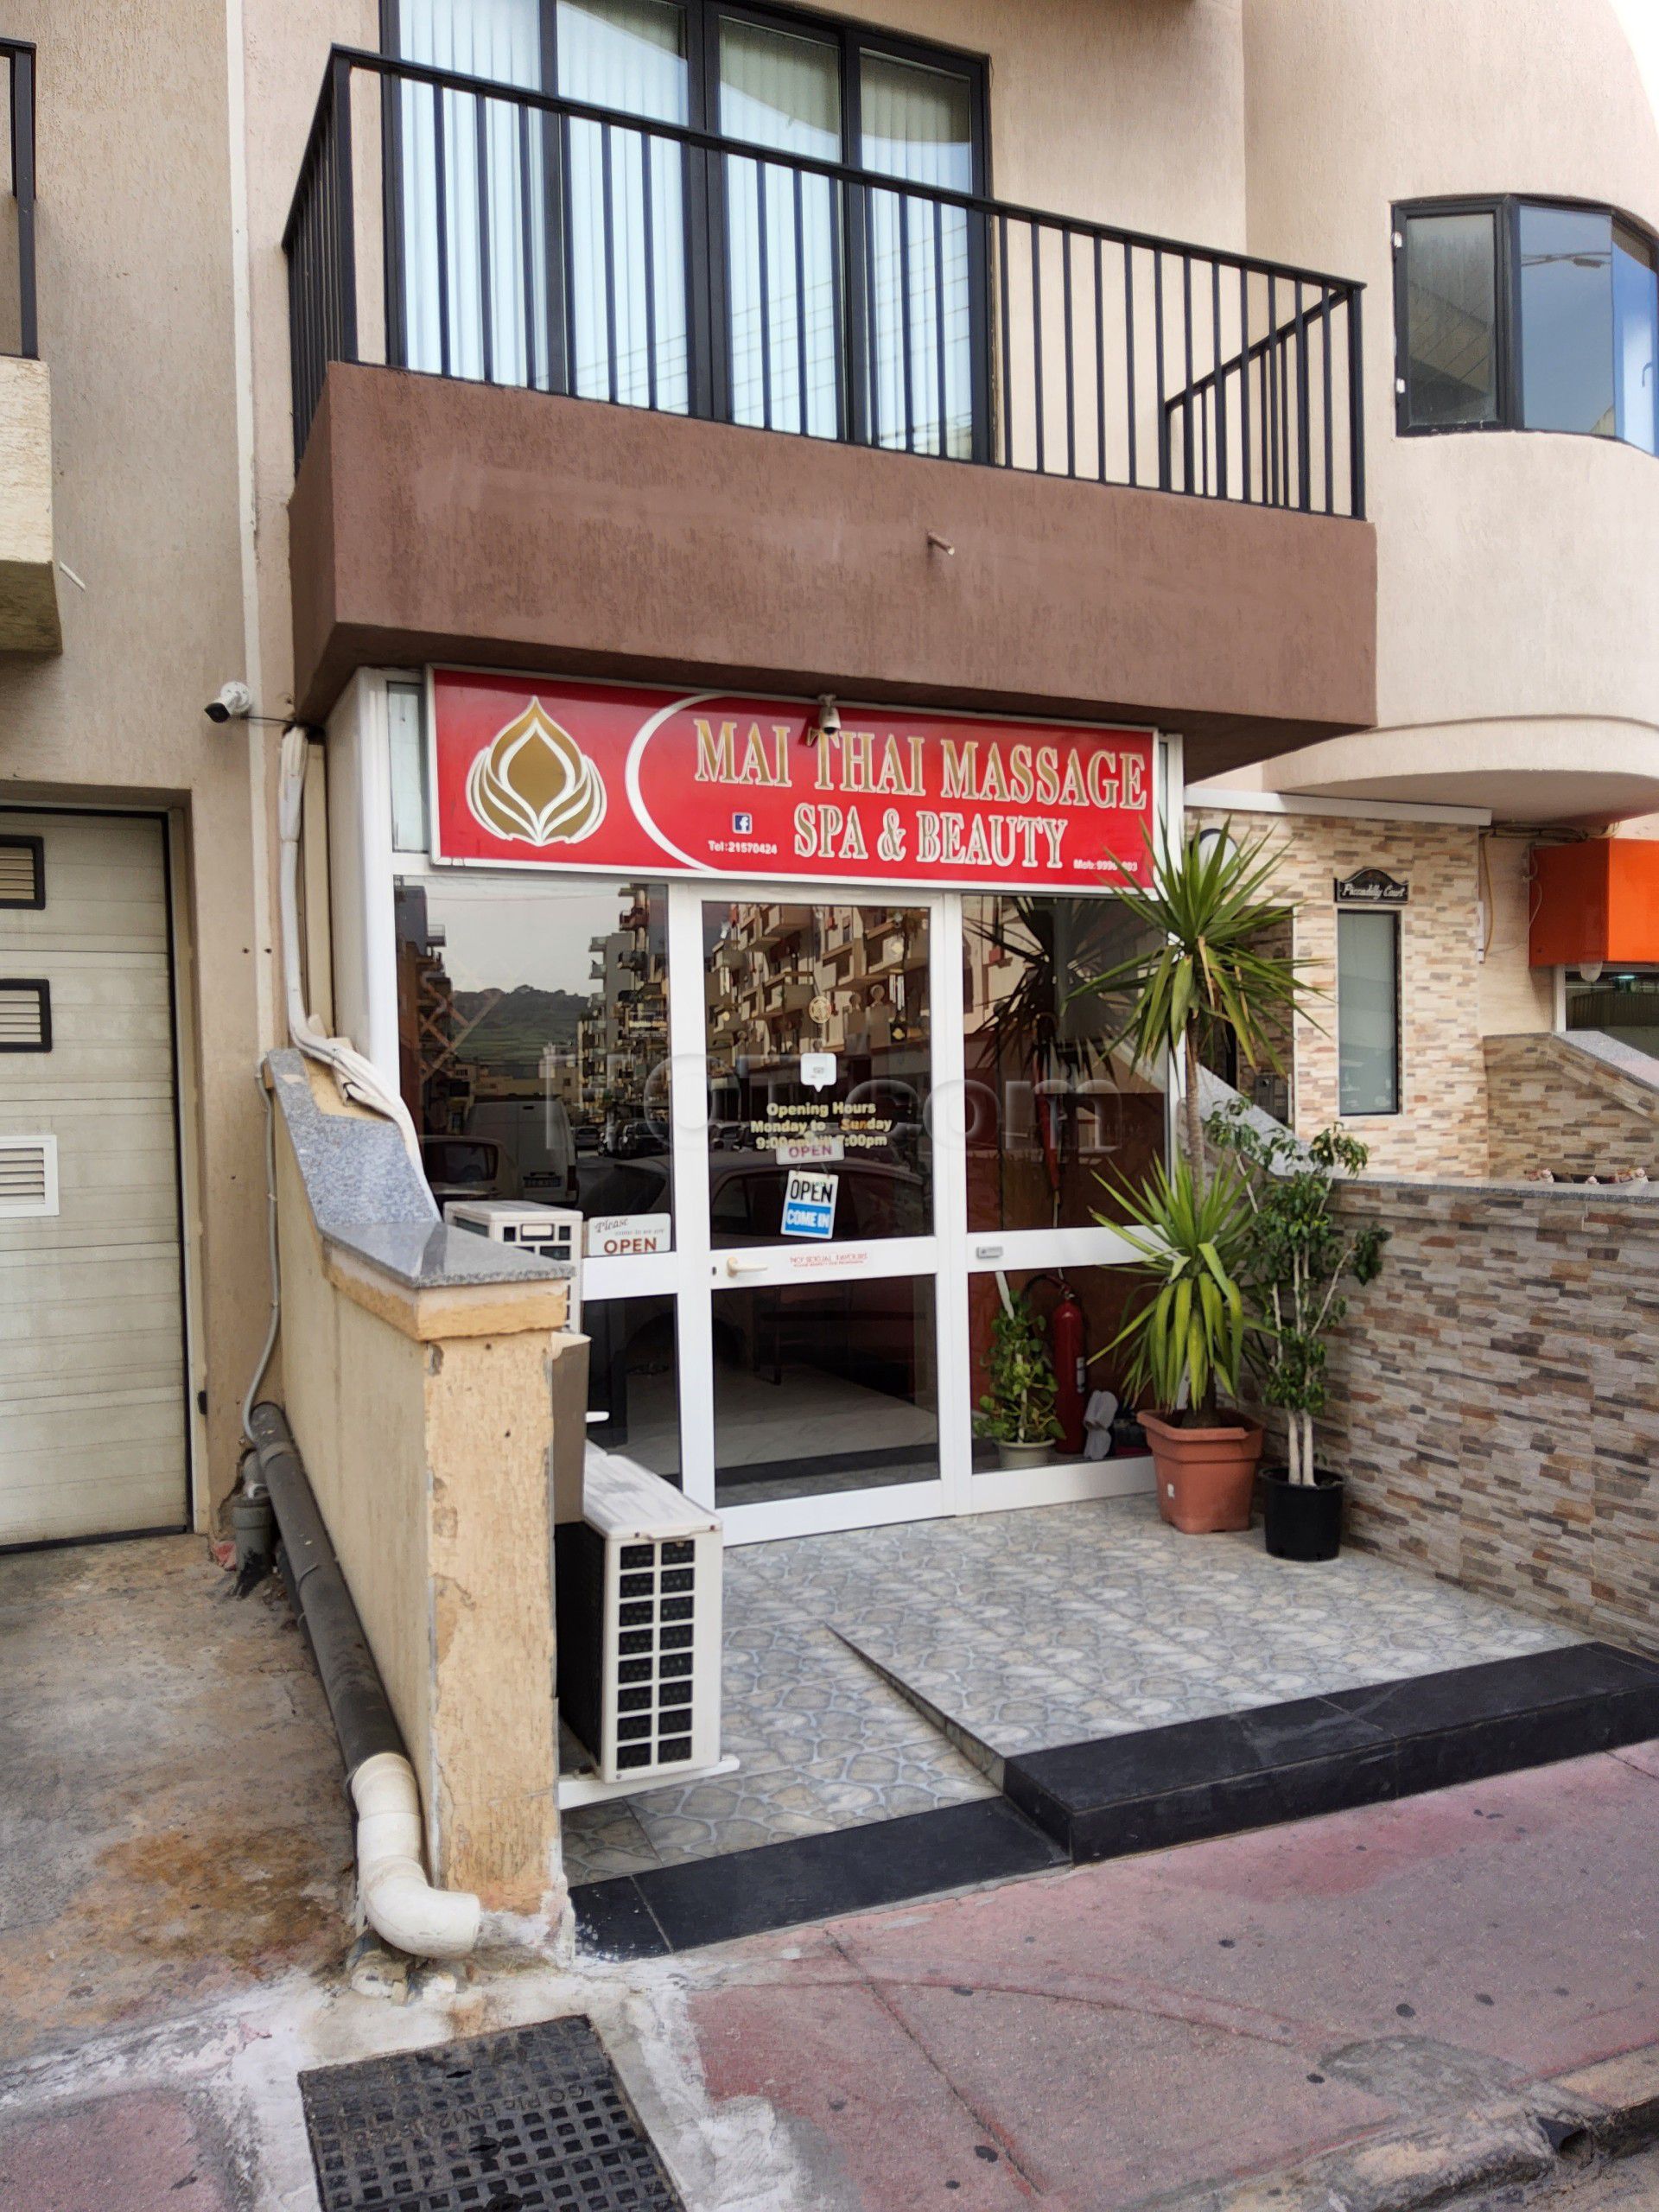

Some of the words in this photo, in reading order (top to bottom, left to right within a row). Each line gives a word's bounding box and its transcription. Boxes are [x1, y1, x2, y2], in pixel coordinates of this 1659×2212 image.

[694, 719, 792, 787] MAI
[806, 726, 927, 796] THAI
[940, 739, 1147, 810] MASSAGE
[794, 803, 869, 860] SPA
[877, 808, 906, 861] &
[916, 810, 1068, 869] BEAUTY
[1383, 885, 1405, 897] Court
[766, 1102, 829, 1119] Opening
[832, 1101, 877, 1116] Hours
[750, 1120, 808, 1135] Monday
[810, 1120, 827, 1132] to
[840, 1117, 893, 1134] Sunday
[788, 1146, 833, 1159] OPEN
[790, 1179, 834, 1204] OPEN
[594, 1217, 629, 1234] Please
[787, 1210, 817, 1227] COME
[817, 1212, 830, 1229] IN
[603, 1237, 658, 1255] OPEN
